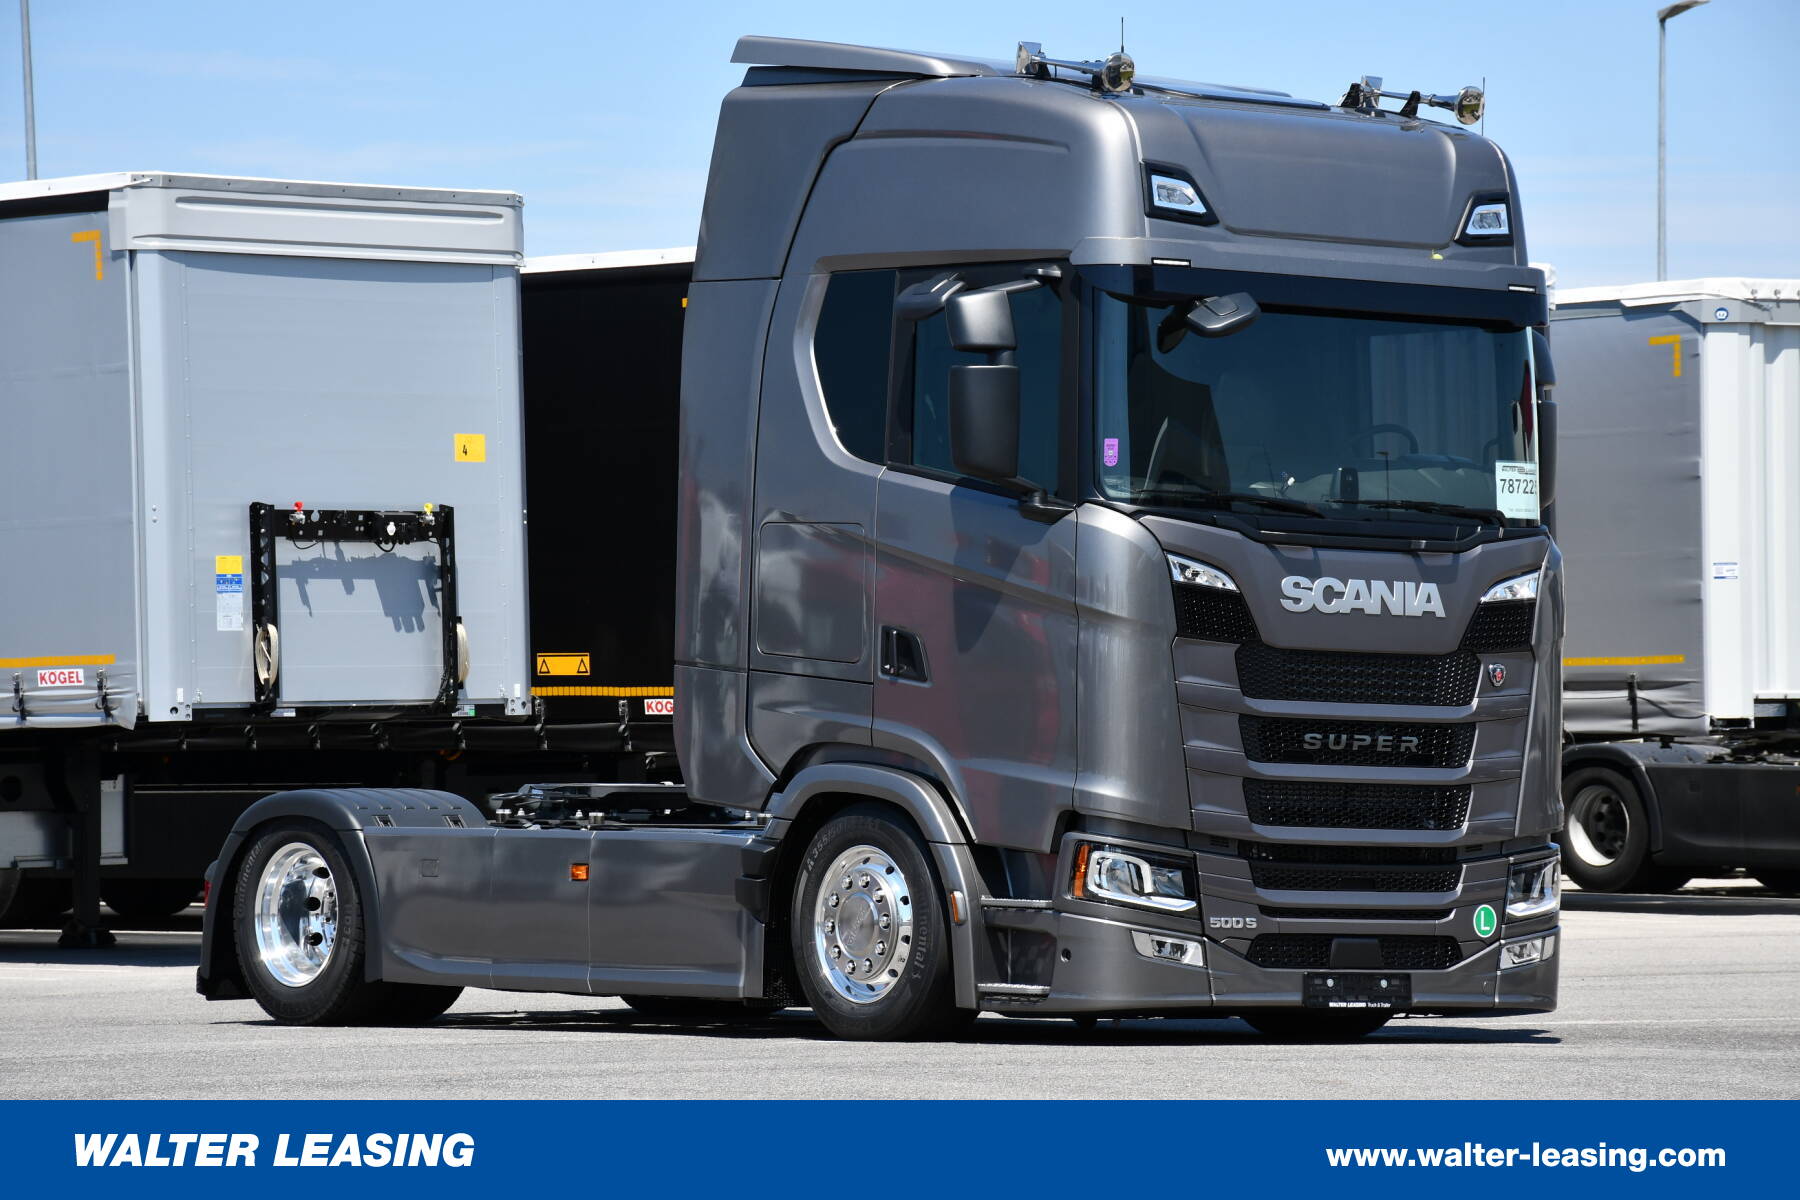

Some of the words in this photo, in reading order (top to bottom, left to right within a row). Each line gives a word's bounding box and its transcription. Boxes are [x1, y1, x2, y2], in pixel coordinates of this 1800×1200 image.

[1280, 575, 1446, 618] SCANIA
[646, 700, 674, 713] KÖG
[1303, 732, 1419, 753] SUPER
[1209, 917, 1244, 929] 500
[1245, 917, 1257, 929] S
[1480, 910, 1490, 931] L
